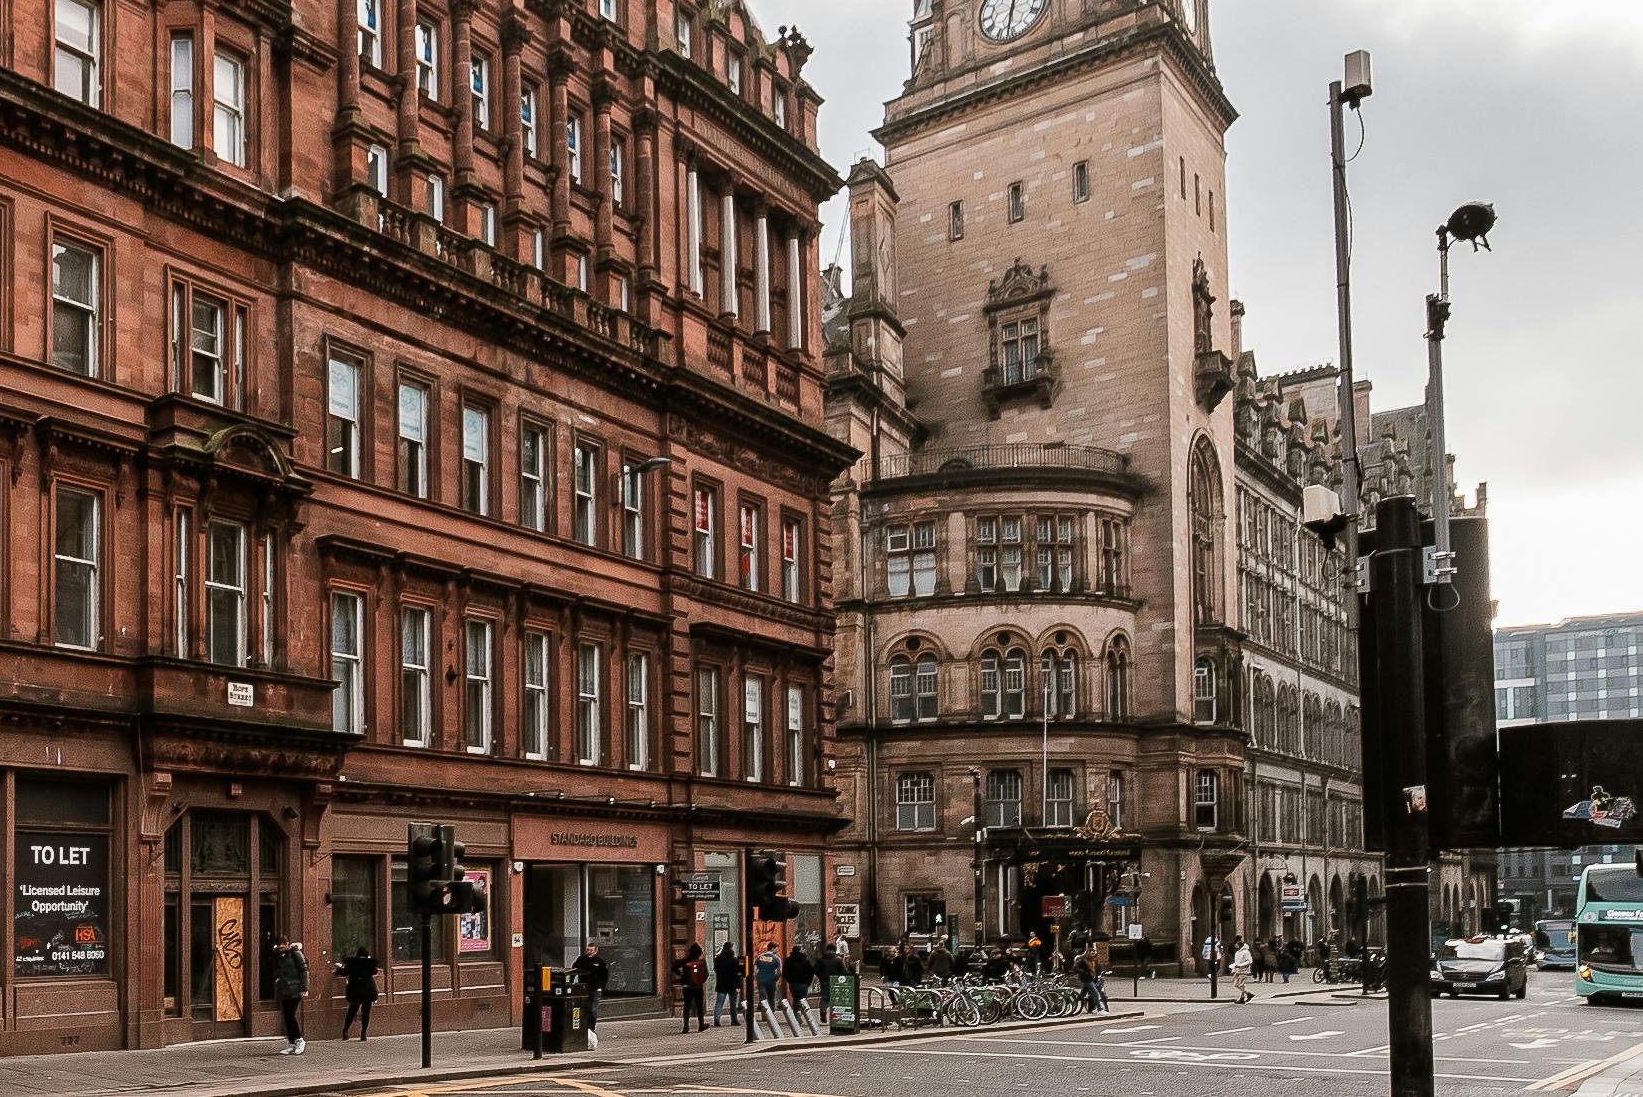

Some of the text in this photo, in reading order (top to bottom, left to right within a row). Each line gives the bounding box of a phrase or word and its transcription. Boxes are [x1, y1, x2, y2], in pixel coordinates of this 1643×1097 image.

[550, 831, 596, 846] STANDARD
[30, 845, 91, 865] TO LET
[19, 884, 100, 896] ‘Licensed Leisure
[31, 900, 89, 913] Opportunity’
[51, 951, 70, 961] 0141
[71, 950, 86, 960] 548
